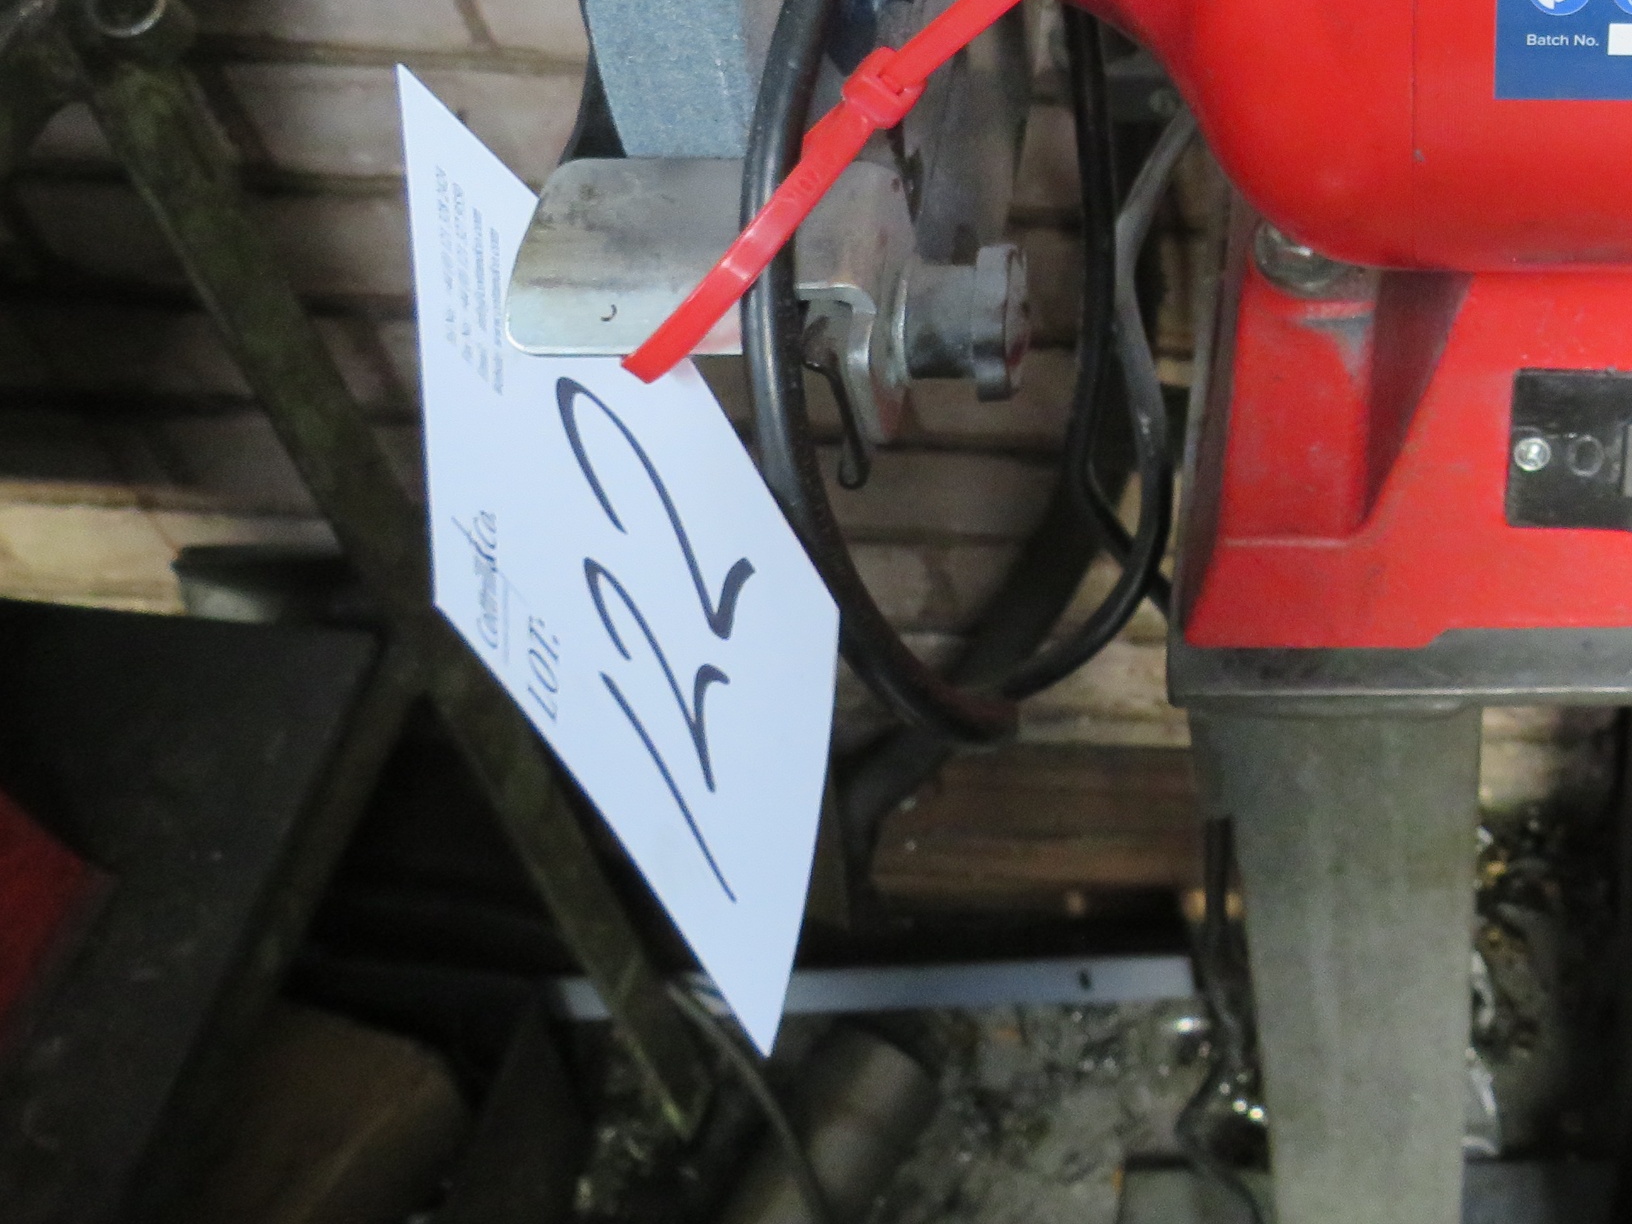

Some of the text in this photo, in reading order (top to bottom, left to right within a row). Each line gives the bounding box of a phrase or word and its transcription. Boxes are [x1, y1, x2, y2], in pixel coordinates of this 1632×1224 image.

[1526, 33, 1600, 47] Batch No.
[556, 376, 756, 904] 122
